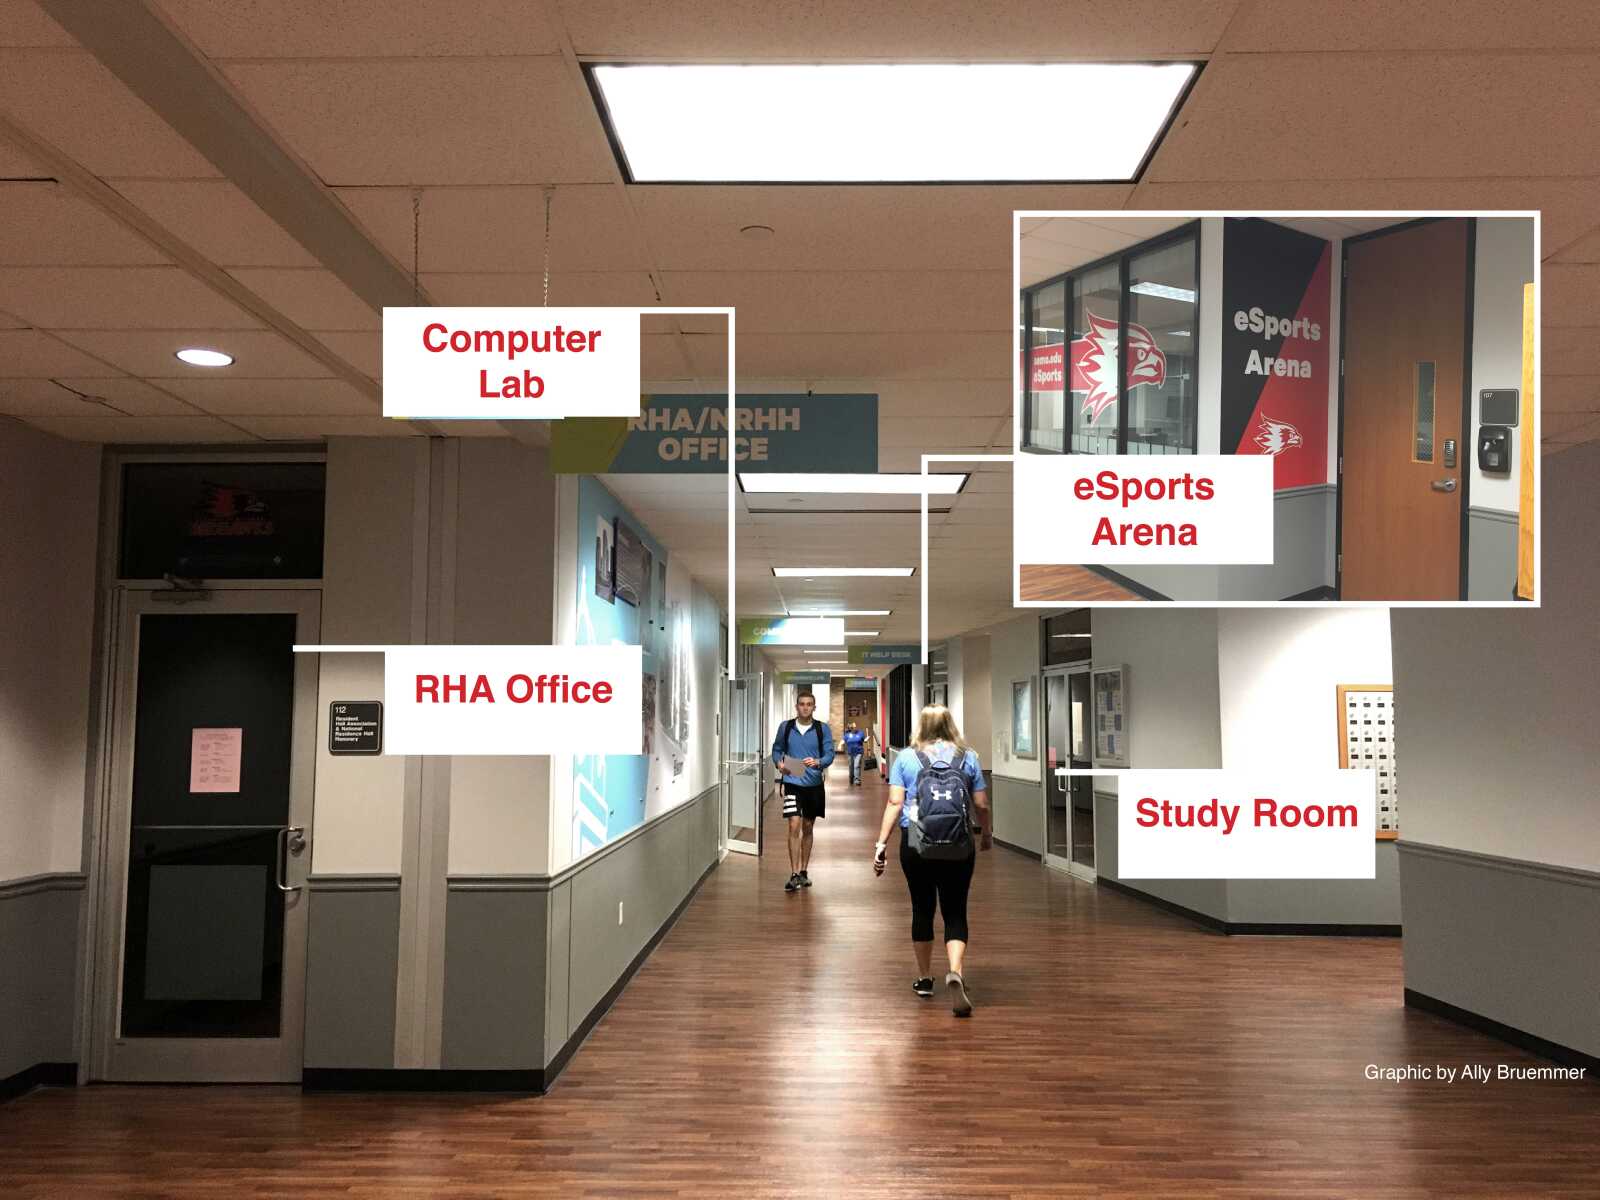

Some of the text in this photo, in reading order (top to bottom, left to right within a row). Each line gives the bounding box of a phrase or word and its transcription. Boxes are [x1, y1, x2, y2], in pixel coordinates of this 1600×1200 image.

[1234, 307, 1320, 341] eSports
[1244, 349, 1311, 378] Arena
[627, 407, 800, 433] RHA/NRHH
[658, 437, 768, 461] OFFICE
[335, 706, 346, 714] 112
